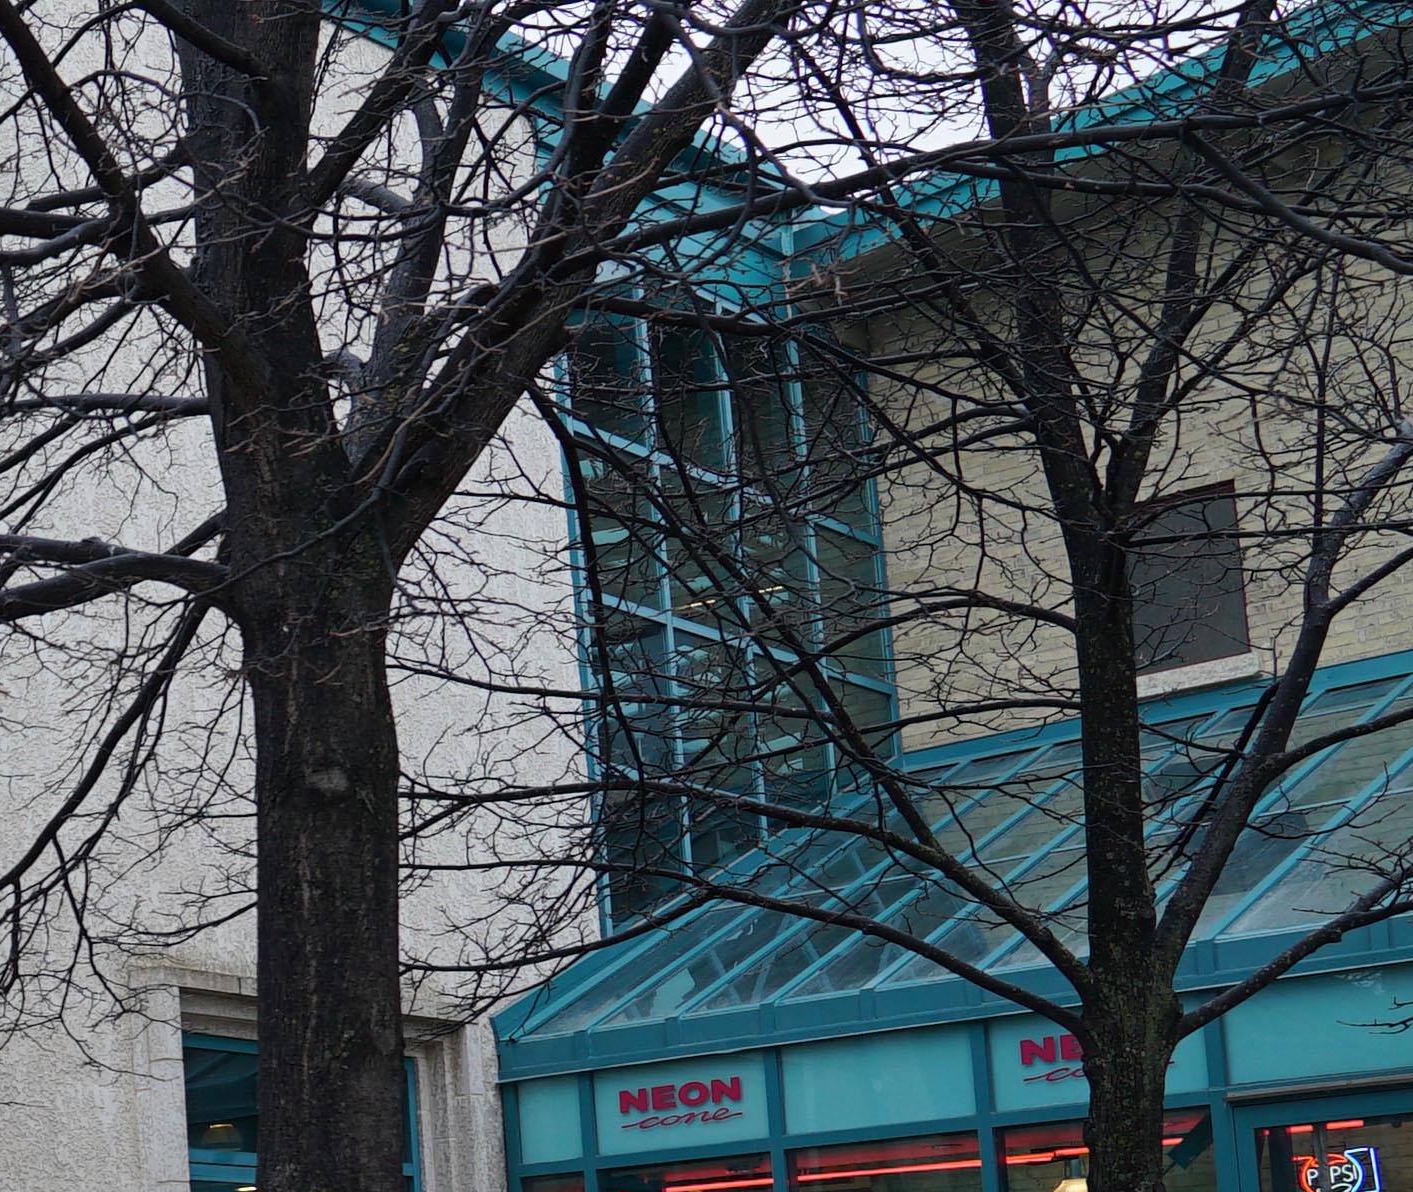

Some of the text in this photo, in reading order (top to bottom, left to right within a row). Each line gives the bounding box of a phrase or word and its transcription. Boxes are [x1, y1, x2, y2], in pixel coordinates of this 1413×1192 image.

[1019, 1034, 1085, 1066] NE
[619, 1076, 743, 1114] NEON
[621, 1107, 743, 1129] cone
[1307, 1163, 1358, 1186] PPSI
